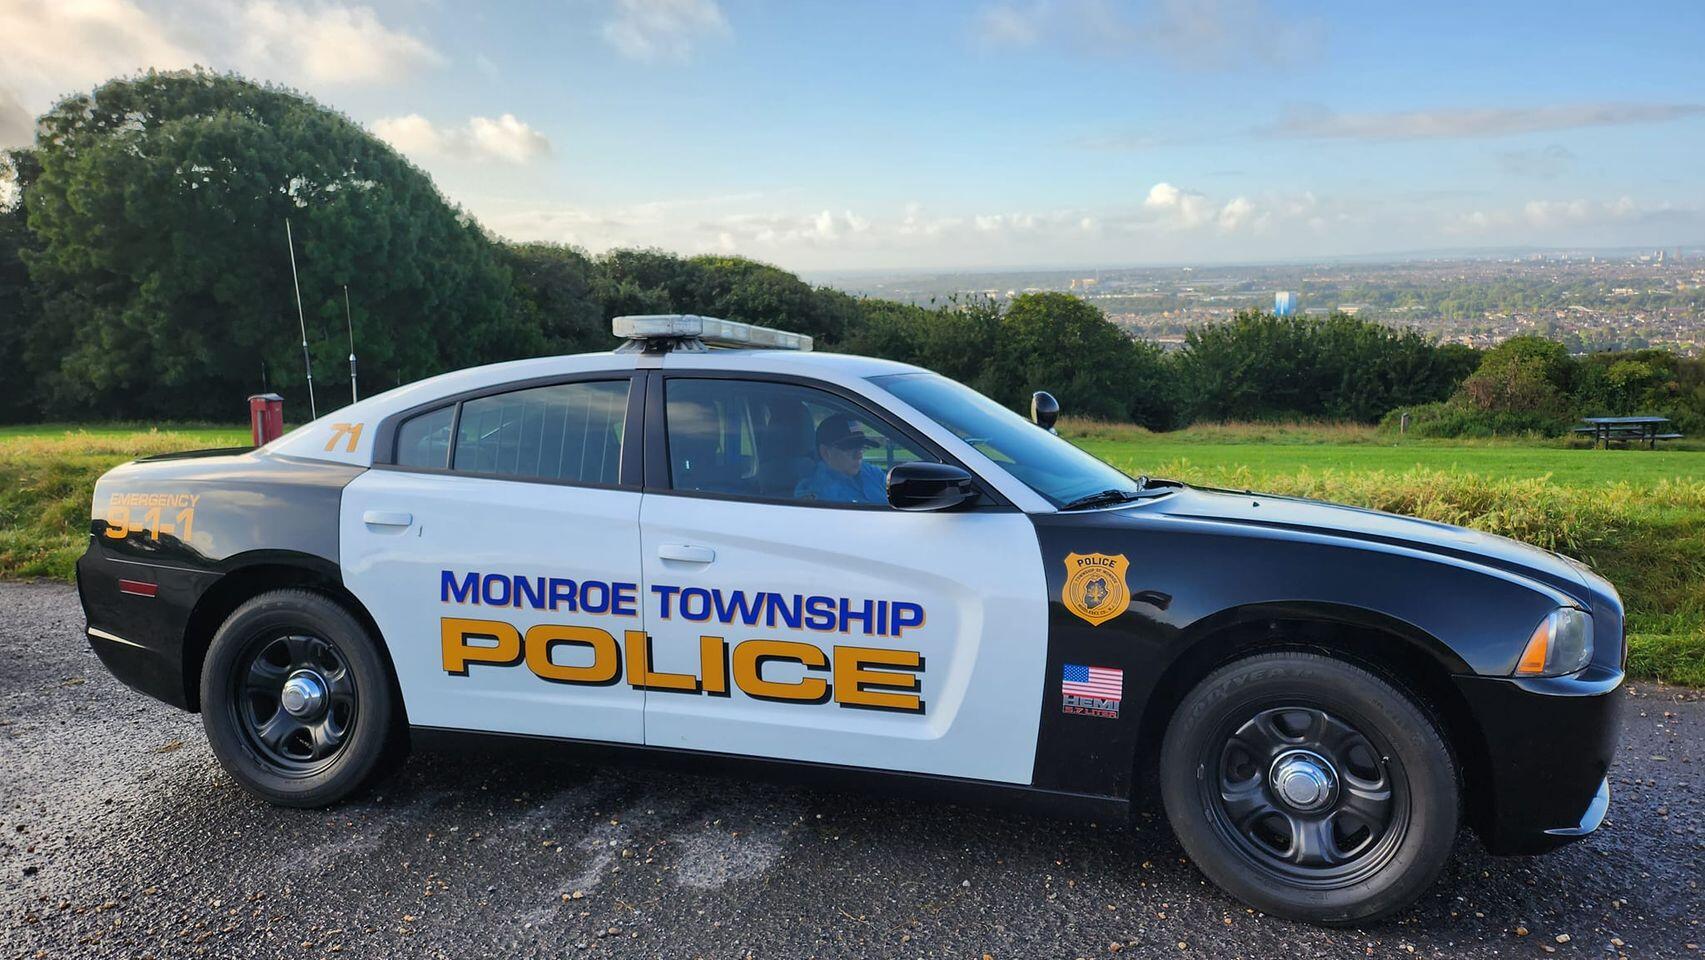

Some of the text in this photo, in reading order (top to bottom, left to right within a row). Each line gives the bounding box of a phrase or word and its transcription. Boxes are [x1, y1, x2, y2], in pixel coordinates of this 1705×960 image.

[324, 422, 365, 453] 71
[111, 492, 200, 507] EMERGENCY
[105, 507, 194, 542] 9-1-1
[1077, 557, 1117, 568] POLICE
[440, 570, 926, 638] MONROE TOWNSHIP
[440, 617, 926, 715] POLICE
[1063, 695, 1120, 711] HEMI
